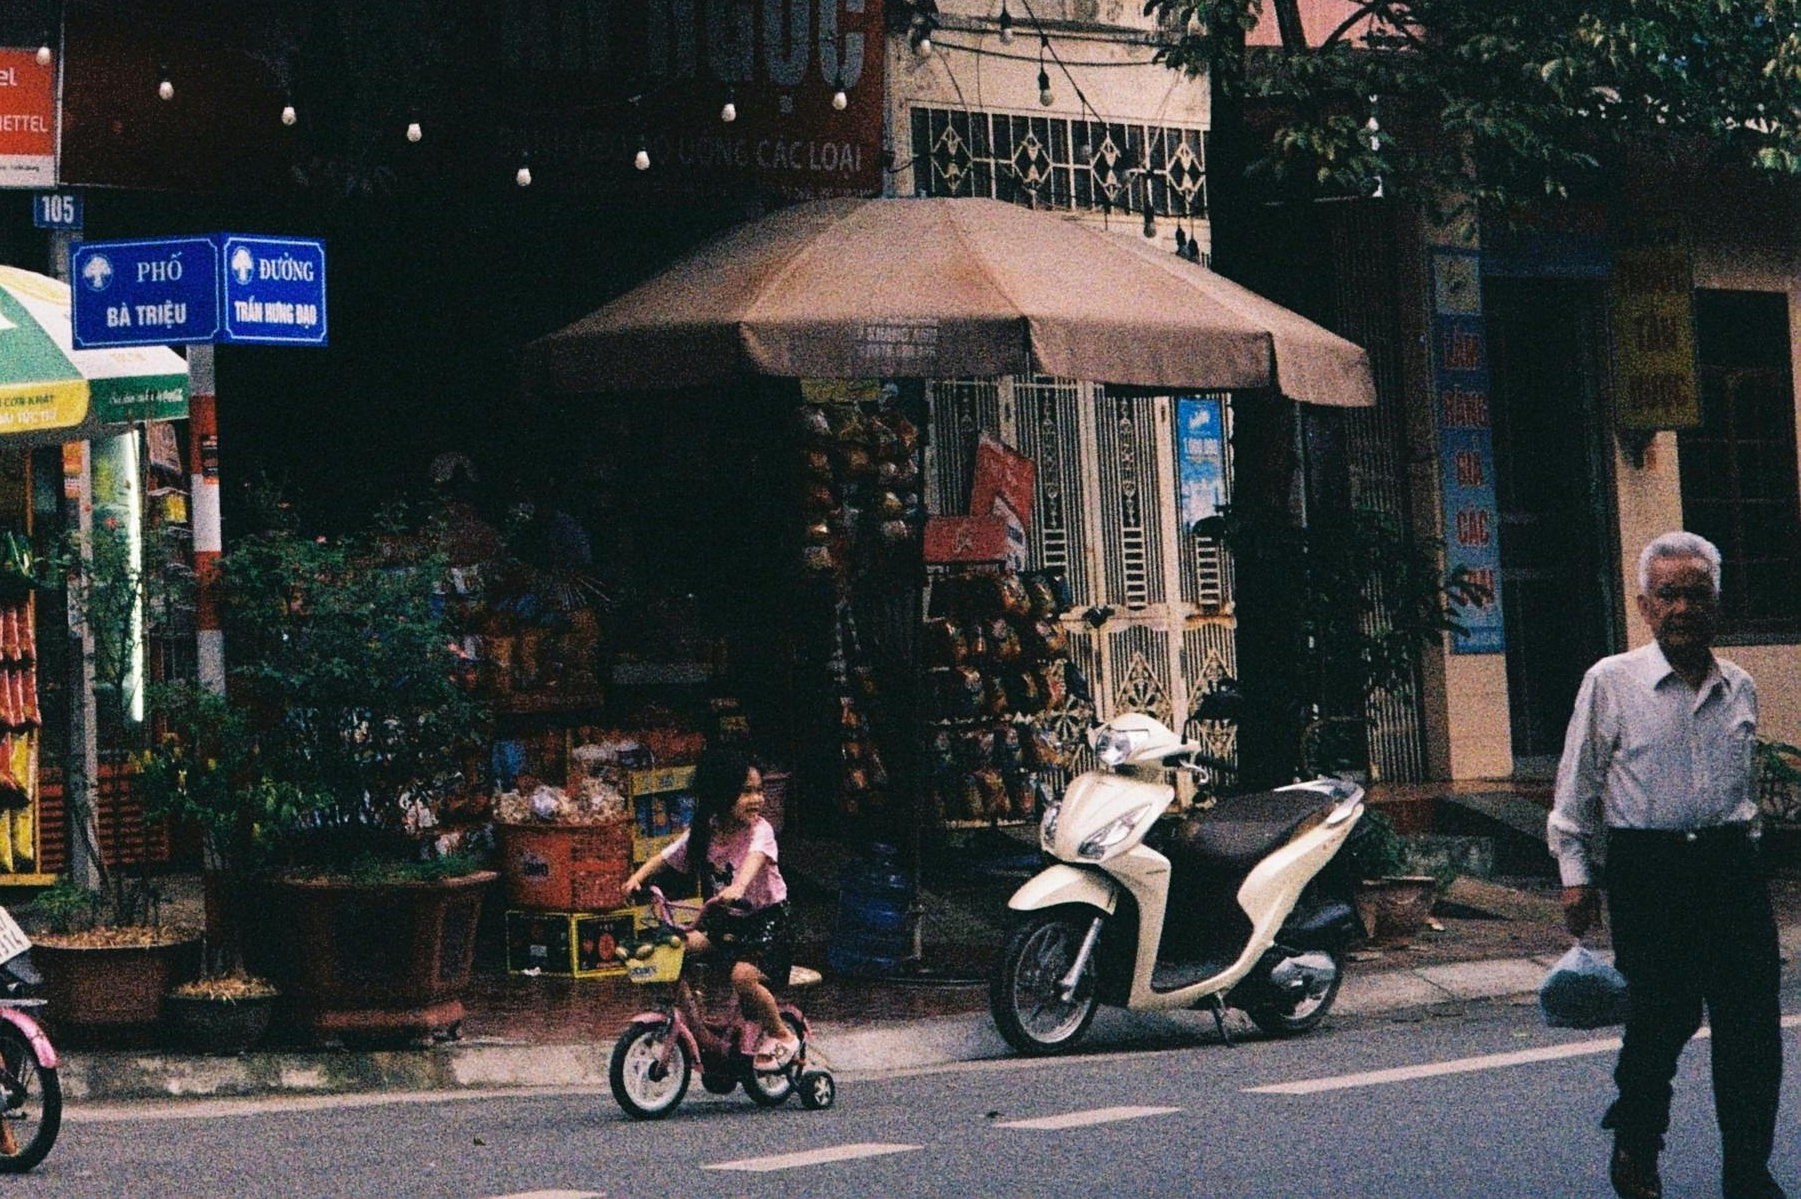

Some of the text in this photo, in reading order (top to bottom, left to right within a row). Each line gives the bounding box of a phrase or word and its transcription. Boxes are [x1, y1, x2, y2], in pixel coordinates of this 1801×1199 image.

[41, 194, 74, 224] 105
[137, 251, 183, 283] PHỐ
[259, 252, 314, 281] ĐƯỜNG
[106, 299, 187, 330] BÀ TRIỆU
[295, 304, 318, 330] ĐẠO
